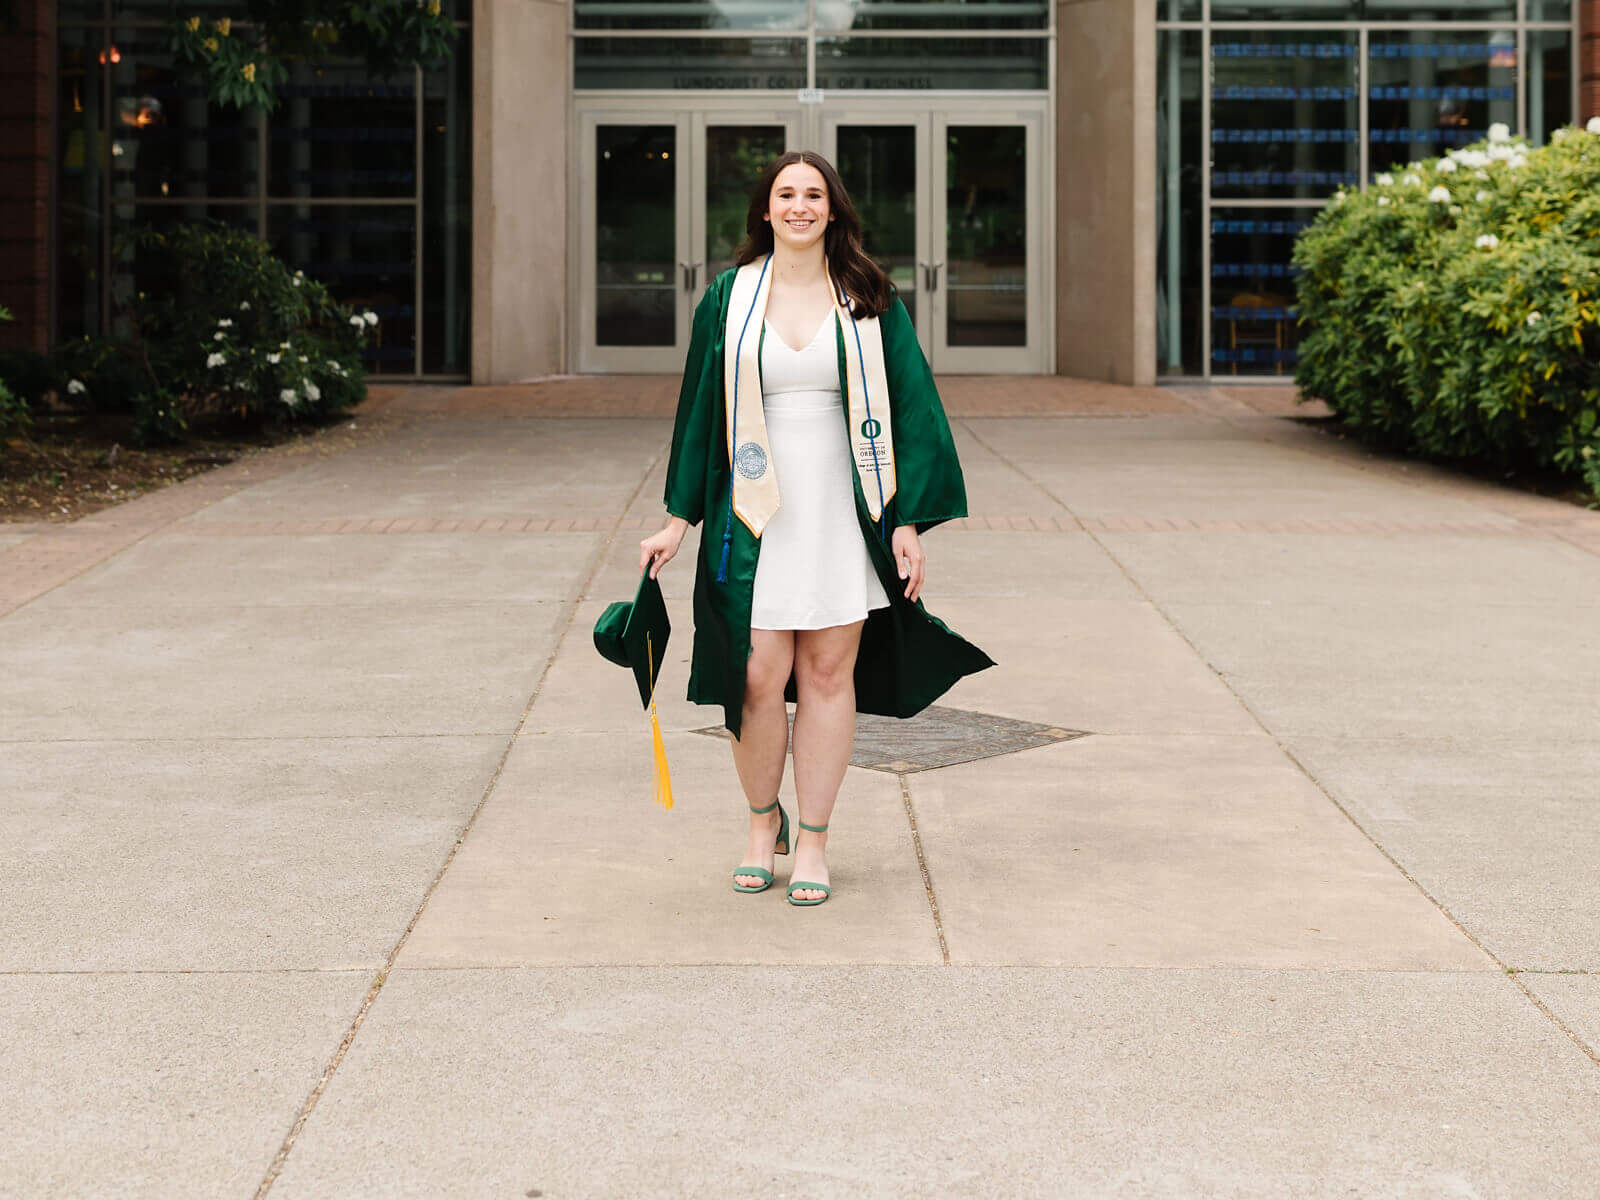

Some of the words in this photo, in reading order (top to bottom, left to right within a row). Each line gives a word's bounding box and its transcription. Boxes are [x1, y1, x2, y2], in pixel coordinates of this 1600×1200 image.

[673, 77, 758, 89] LUNDQUIST
[838, 77, 855, 89] OF
[864, 77, 932, 89] BUSINESS
[861, 418, 881, 439] O
